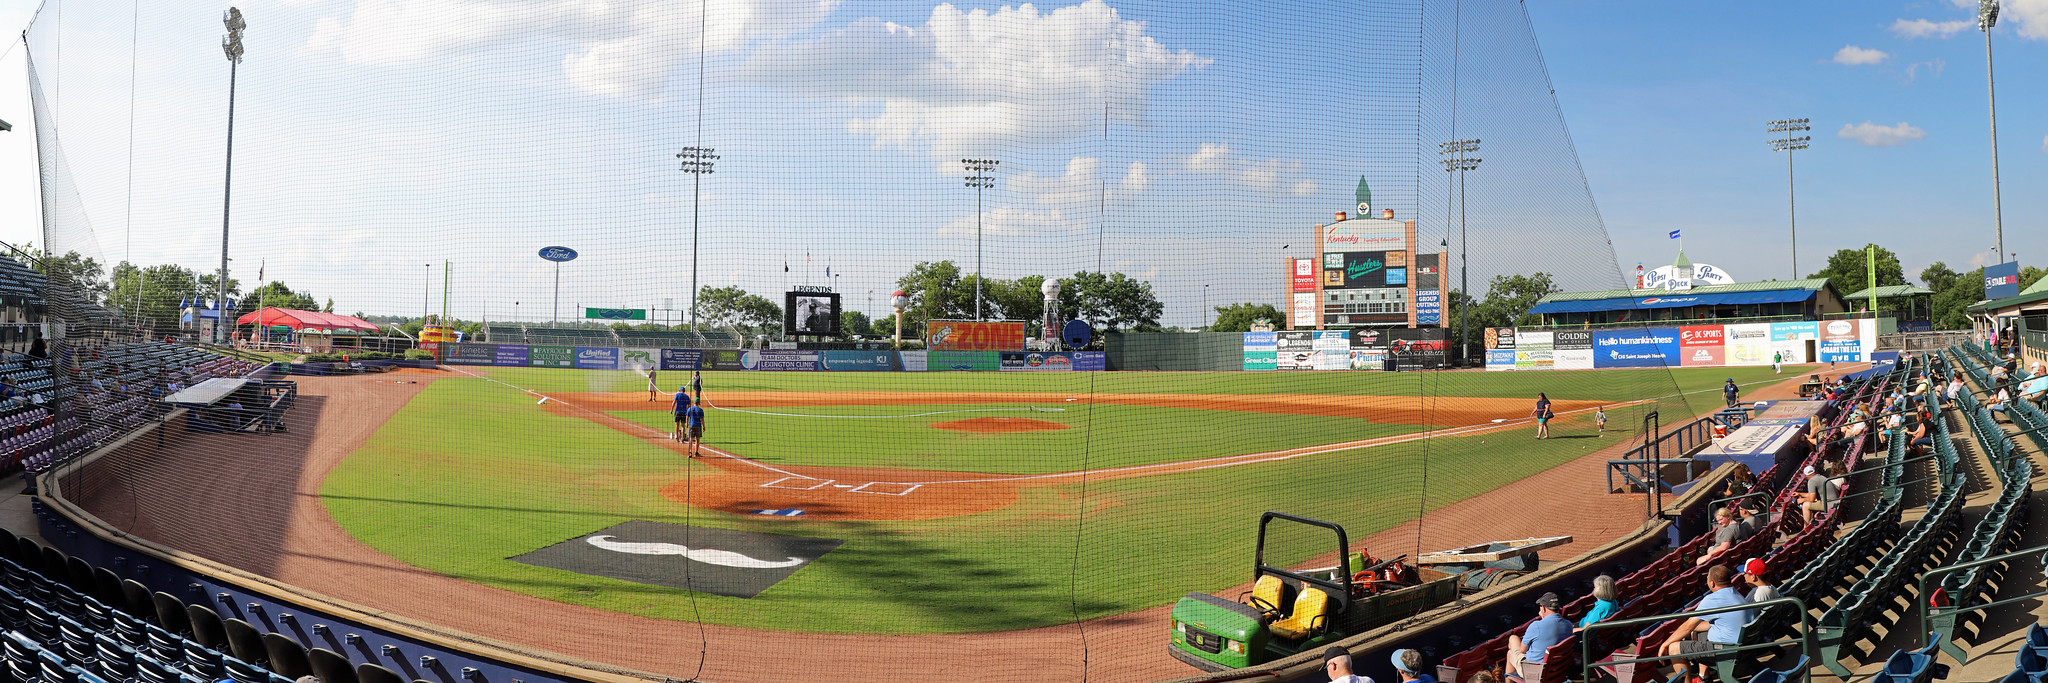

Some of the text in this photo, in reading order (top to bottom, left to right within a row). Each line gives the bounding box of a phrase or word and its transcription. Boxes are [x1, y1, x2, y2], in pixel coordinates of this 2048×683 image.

[1327, 234, 1359, 244] Kentucky
[546, 248, 570, 259] Ford
[1347, 258, 1382, 275] Hustlers
[1646, 266, 1723, 287] PEPSI PARTY
[1668, 279, 1688, 290] DECK
[957, 324, 1025, 350] ZONE
[462, 346, 488, 354] kinetic
[624, 350, 656, 363] PPL
